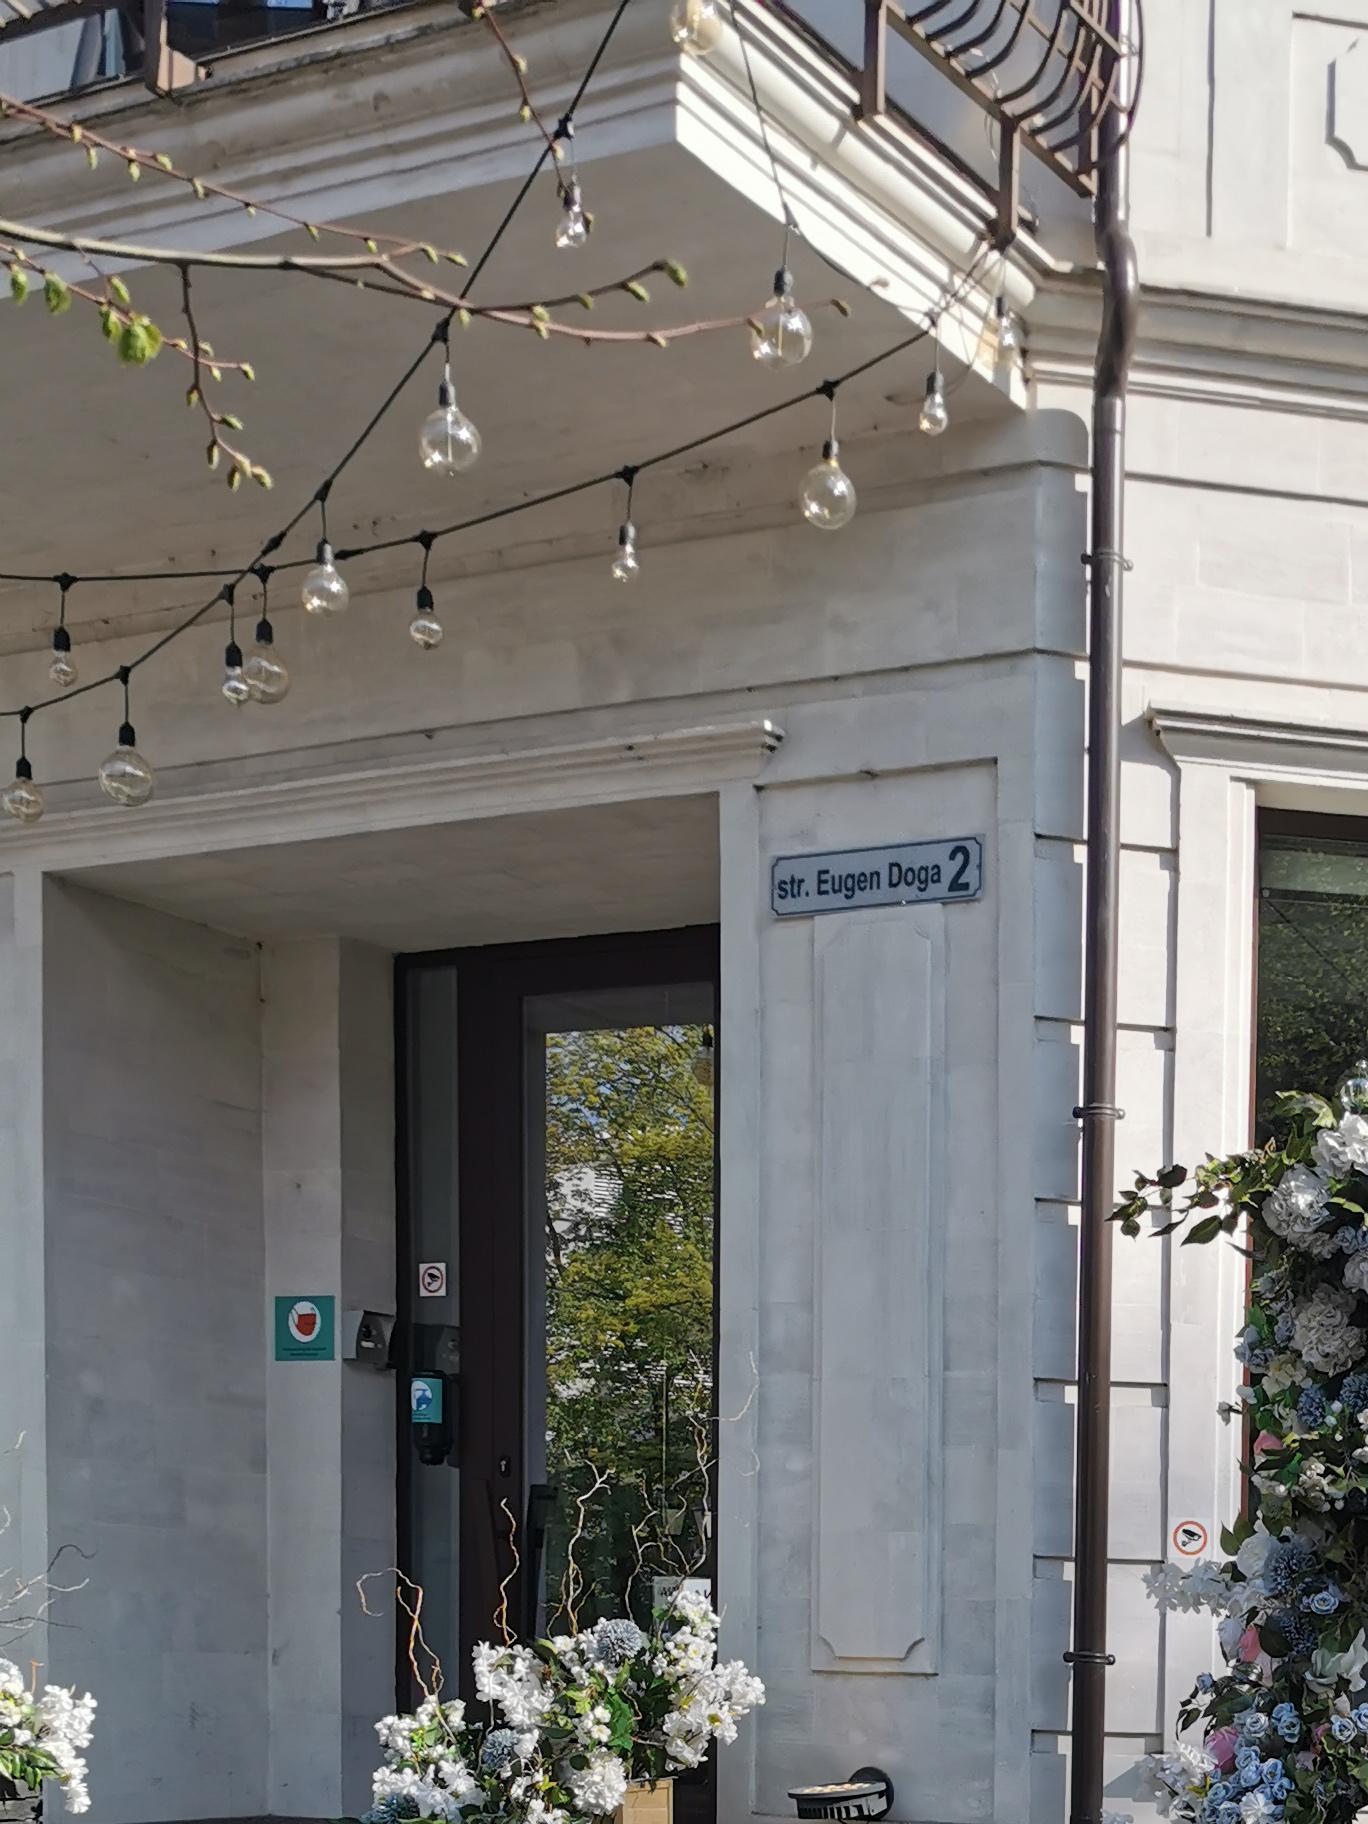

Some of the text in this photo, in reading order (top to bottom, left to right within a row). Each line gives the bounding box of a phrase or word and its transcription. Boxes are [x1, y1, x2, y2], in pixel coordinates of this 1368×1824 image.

[777, 845, 971, 900] str. Eugen Doga 2
